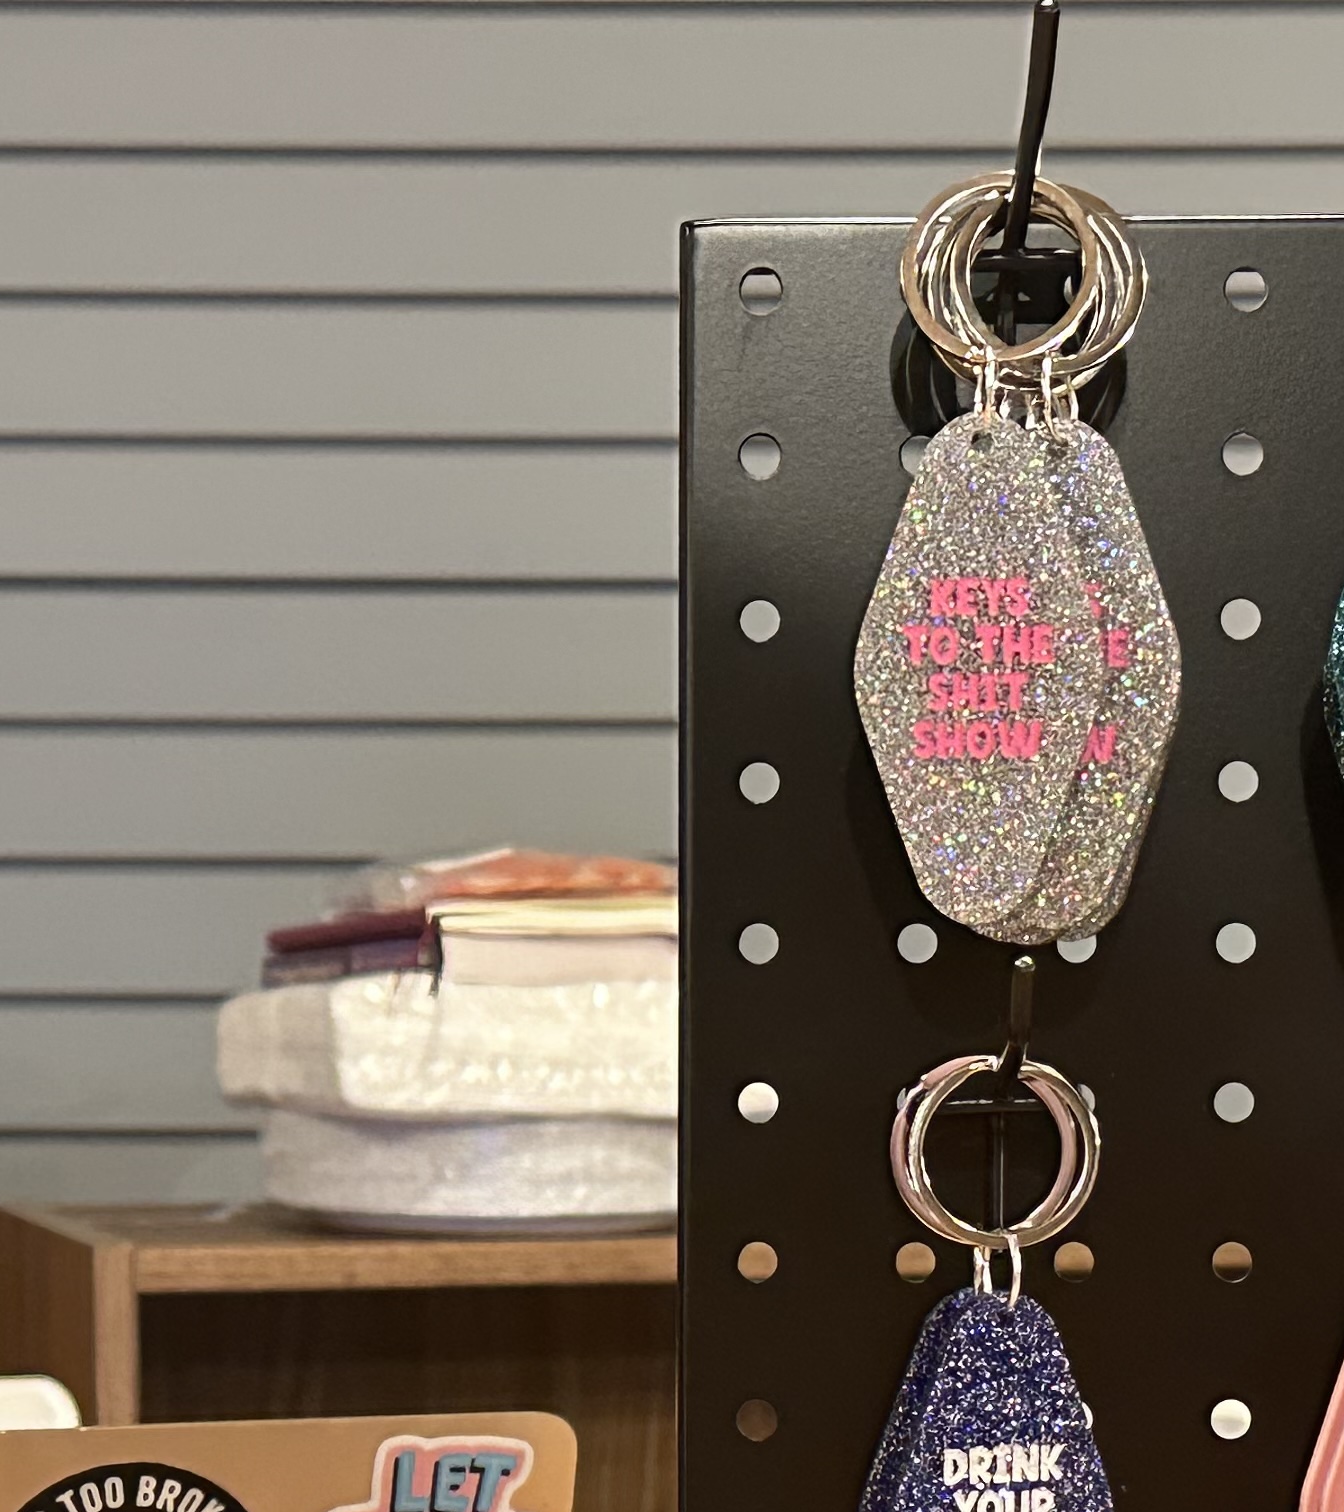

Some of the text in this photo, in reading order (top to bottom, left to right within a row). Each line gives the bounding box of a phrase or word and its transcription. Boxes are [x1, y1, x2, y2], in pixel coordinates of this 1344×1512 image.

[929, 576, 1030, 617] KEYS
[902, 624, 959, 666] TO
[975, 624, 1055, 664] THE
[928, 672, 1029, 711] SHIT
[913, 720, 1043, 759] SHOW
[943, 1443, 1067, 1486] DRINK
